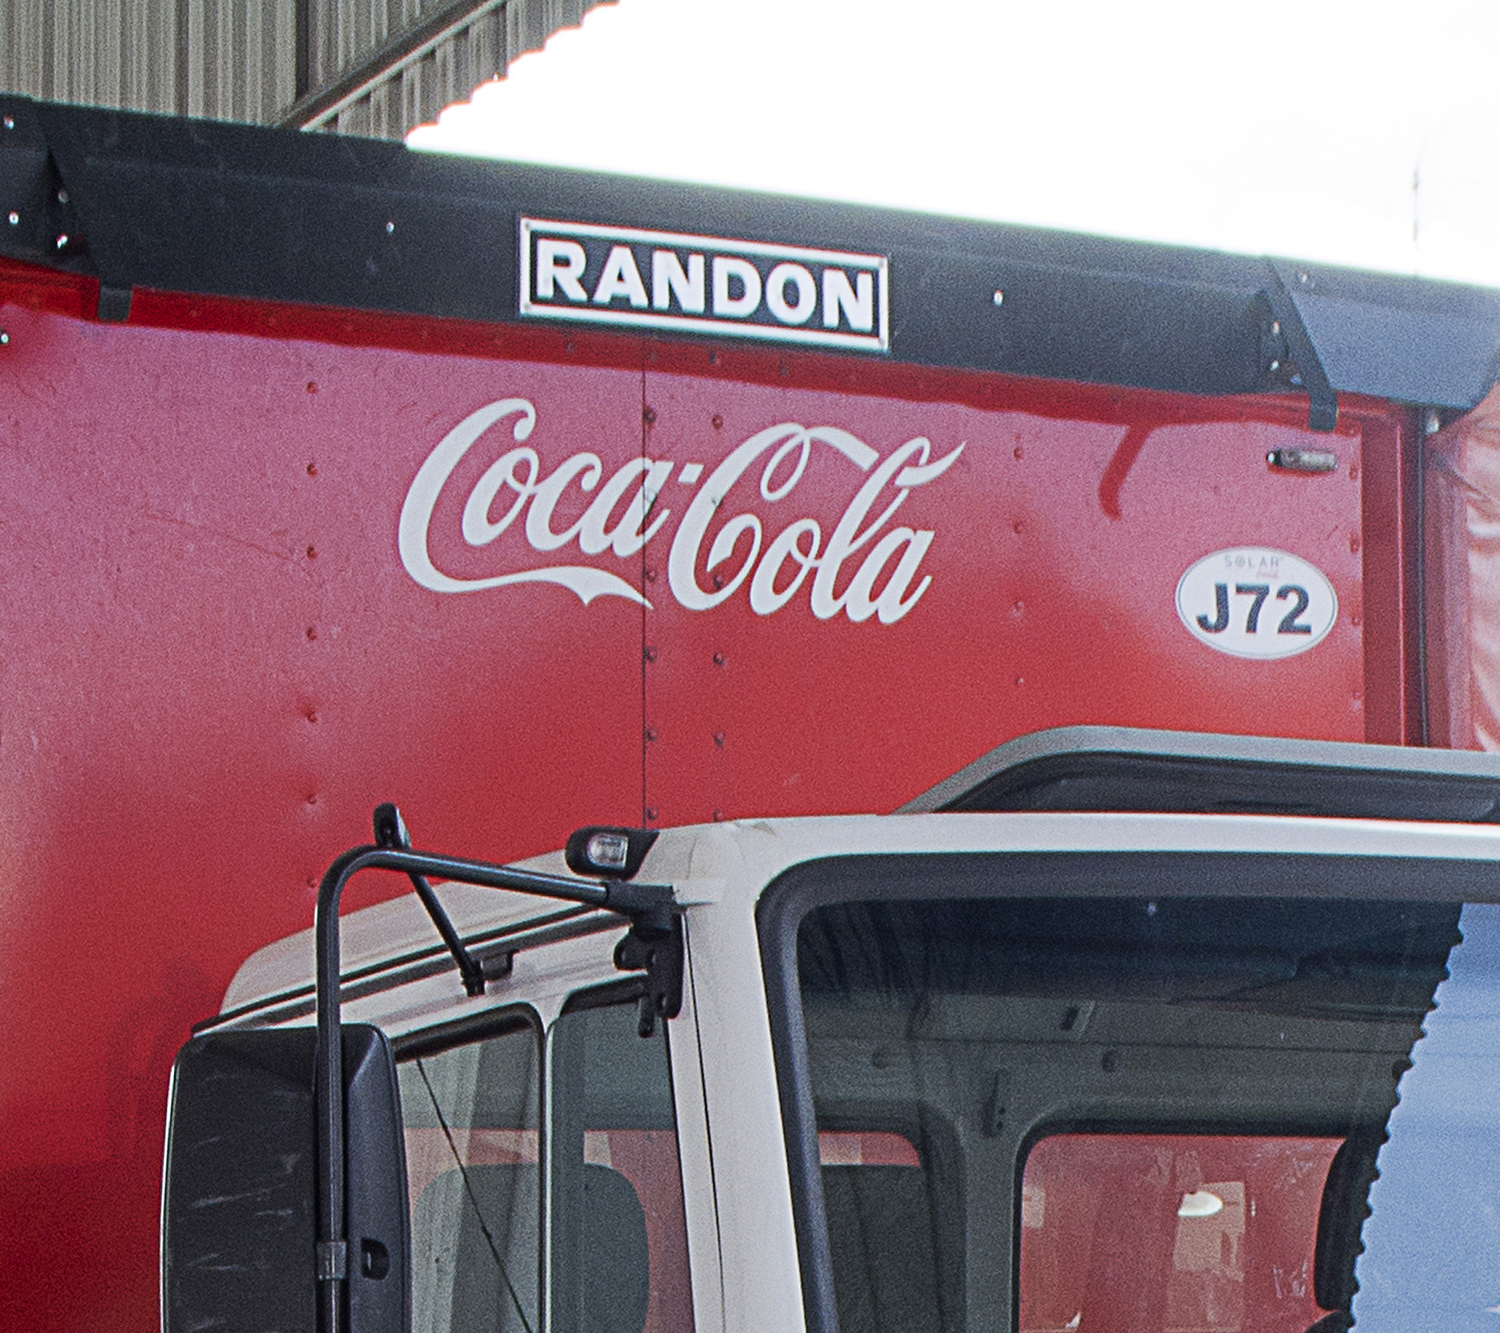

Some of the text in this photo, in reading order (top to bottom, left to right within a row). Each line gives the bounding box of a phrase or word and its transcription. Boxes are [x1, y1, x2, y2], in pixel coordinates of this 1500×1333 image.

[536, 238, 874, 331] RANDON
[398, 397, 967, 625] Coca-Cola
[1196, 582, 1312, 634] J72
